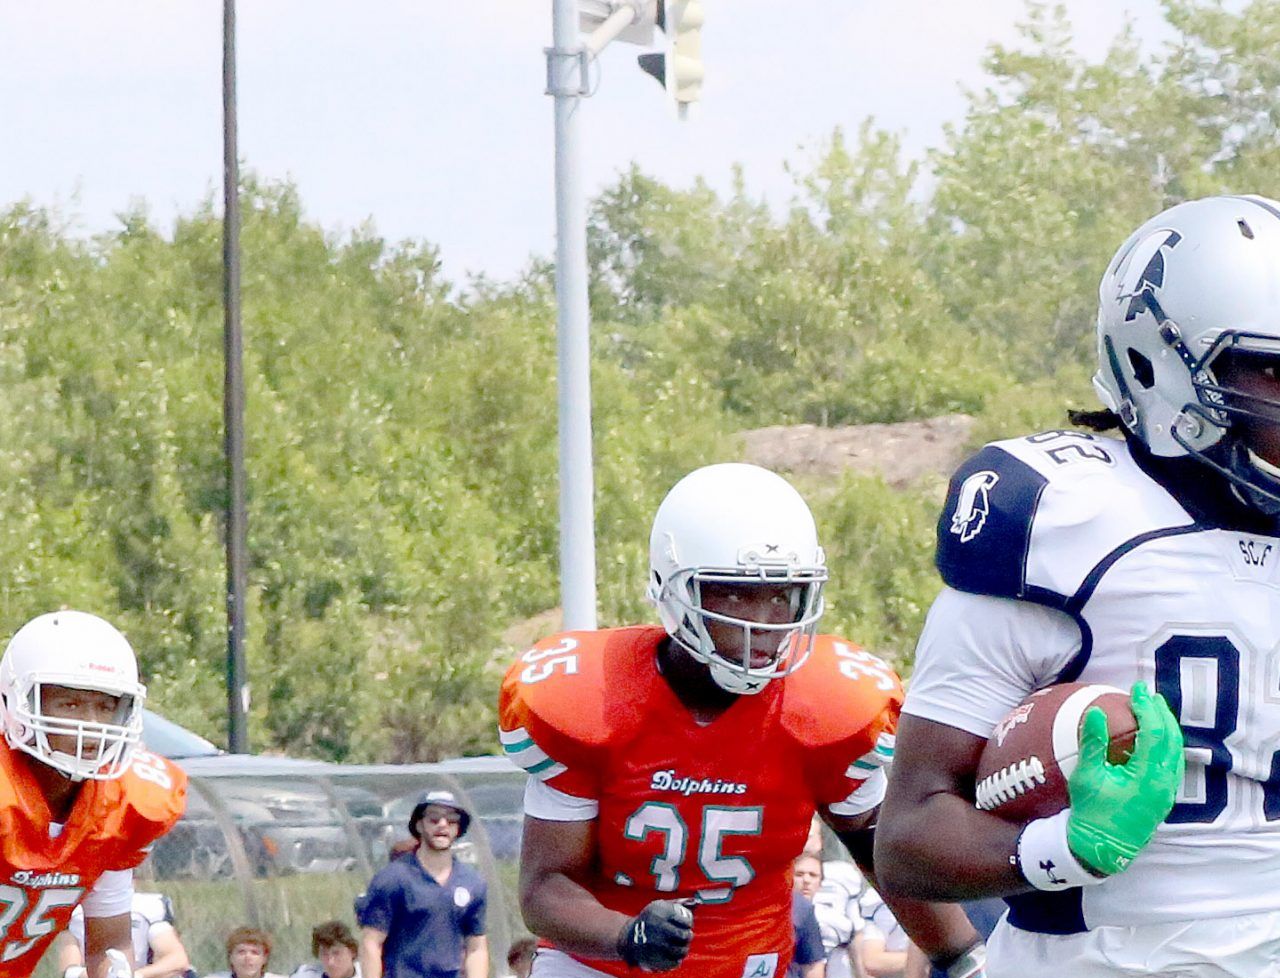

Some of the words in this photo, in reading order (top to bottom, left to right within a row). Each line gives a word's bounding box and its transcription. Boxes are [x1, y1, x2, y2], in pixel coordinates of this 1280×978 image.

[521, 637, 578, 685] 35
[650, 769, 748, 796] Dolphins
[615, 800, 764, 905] 35
